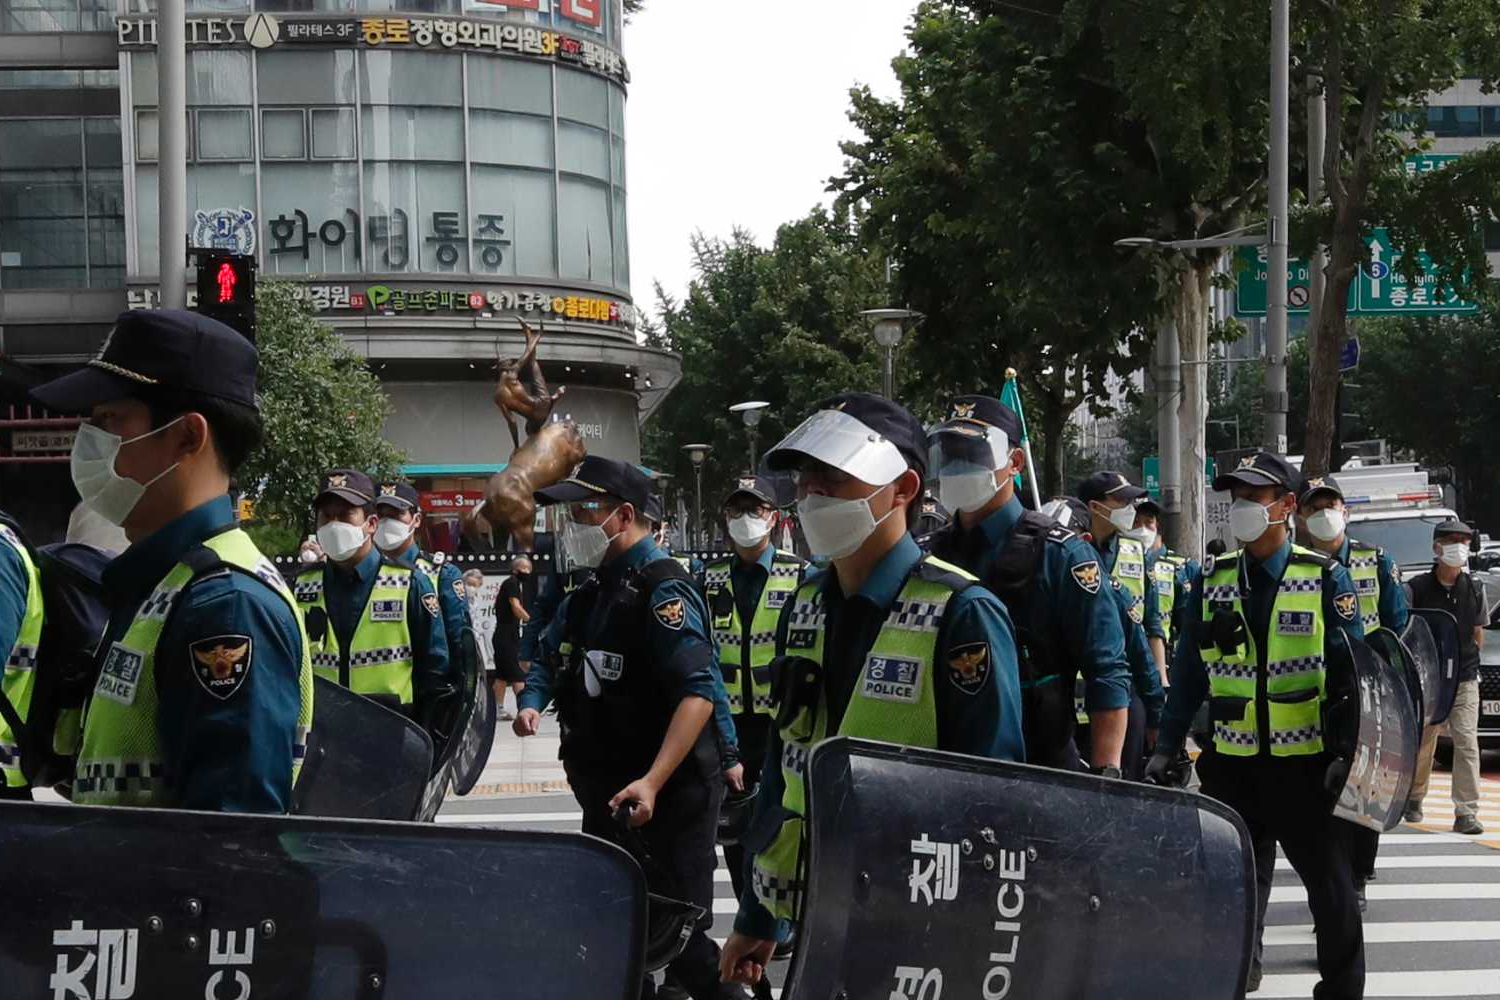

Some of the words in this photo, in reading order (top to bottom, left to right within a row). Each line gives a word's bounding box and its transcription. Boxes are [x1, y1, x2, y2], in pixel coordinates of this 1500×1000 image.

[117, 18, 236, 44] PILTES
[287, 23, 335, 38] 필라테스
[337, 23, 354, 37] 3F
[391, 289, 469, 311] 골프존파크
[100, 675, 132, 698] POLICE
[209, 678, 236, 687] POLICE
[865, 681, 914, 699] POLICE
